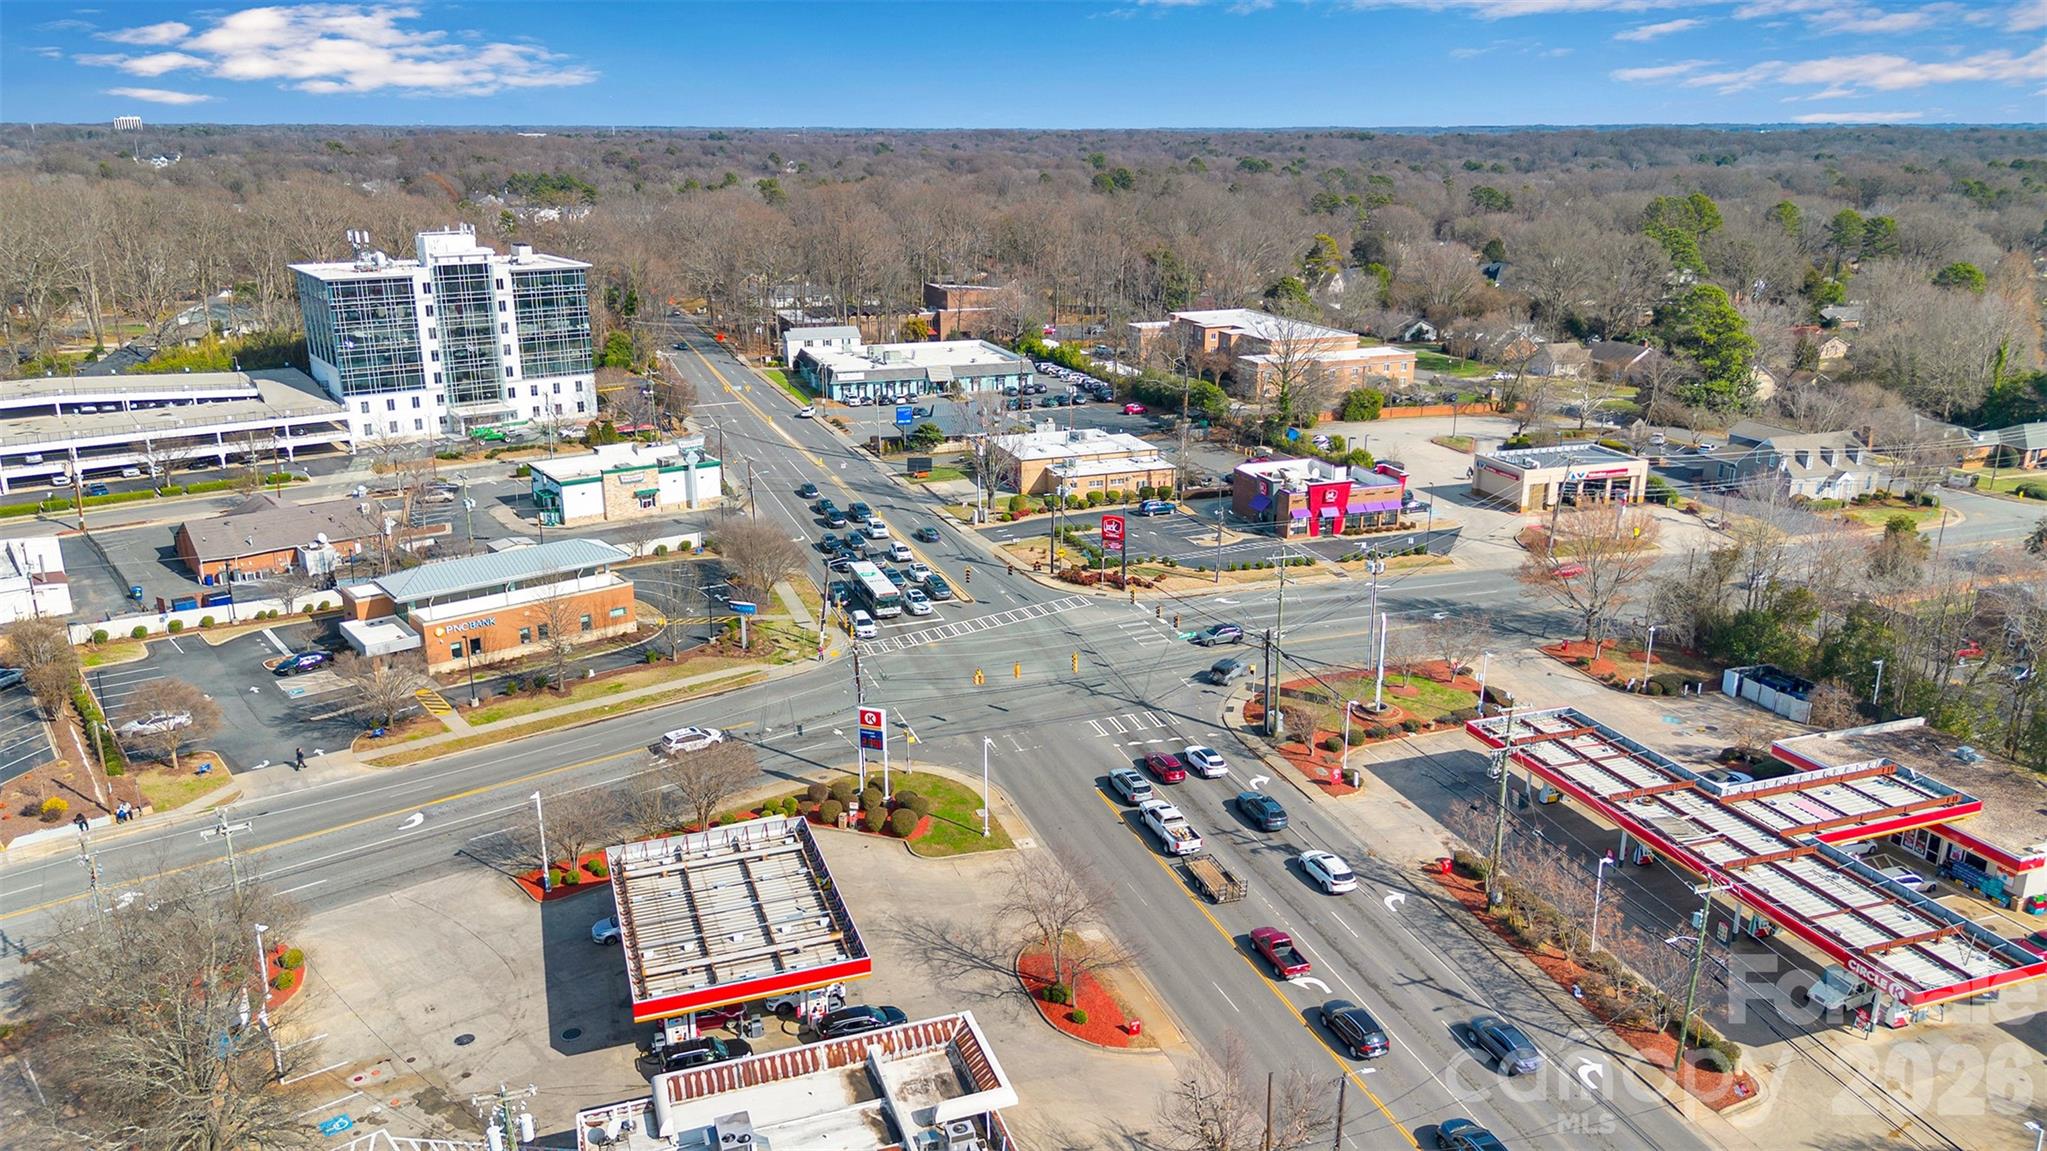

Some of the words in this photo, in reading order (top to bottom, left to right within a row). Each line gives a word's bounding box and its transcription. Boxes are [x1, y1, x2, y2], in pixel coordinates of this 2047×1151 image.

[446, 622, 468, 634] PNC
[468, 616, 496, 630] BANK
[1848, 959, 1888, 990] CIRCLE
